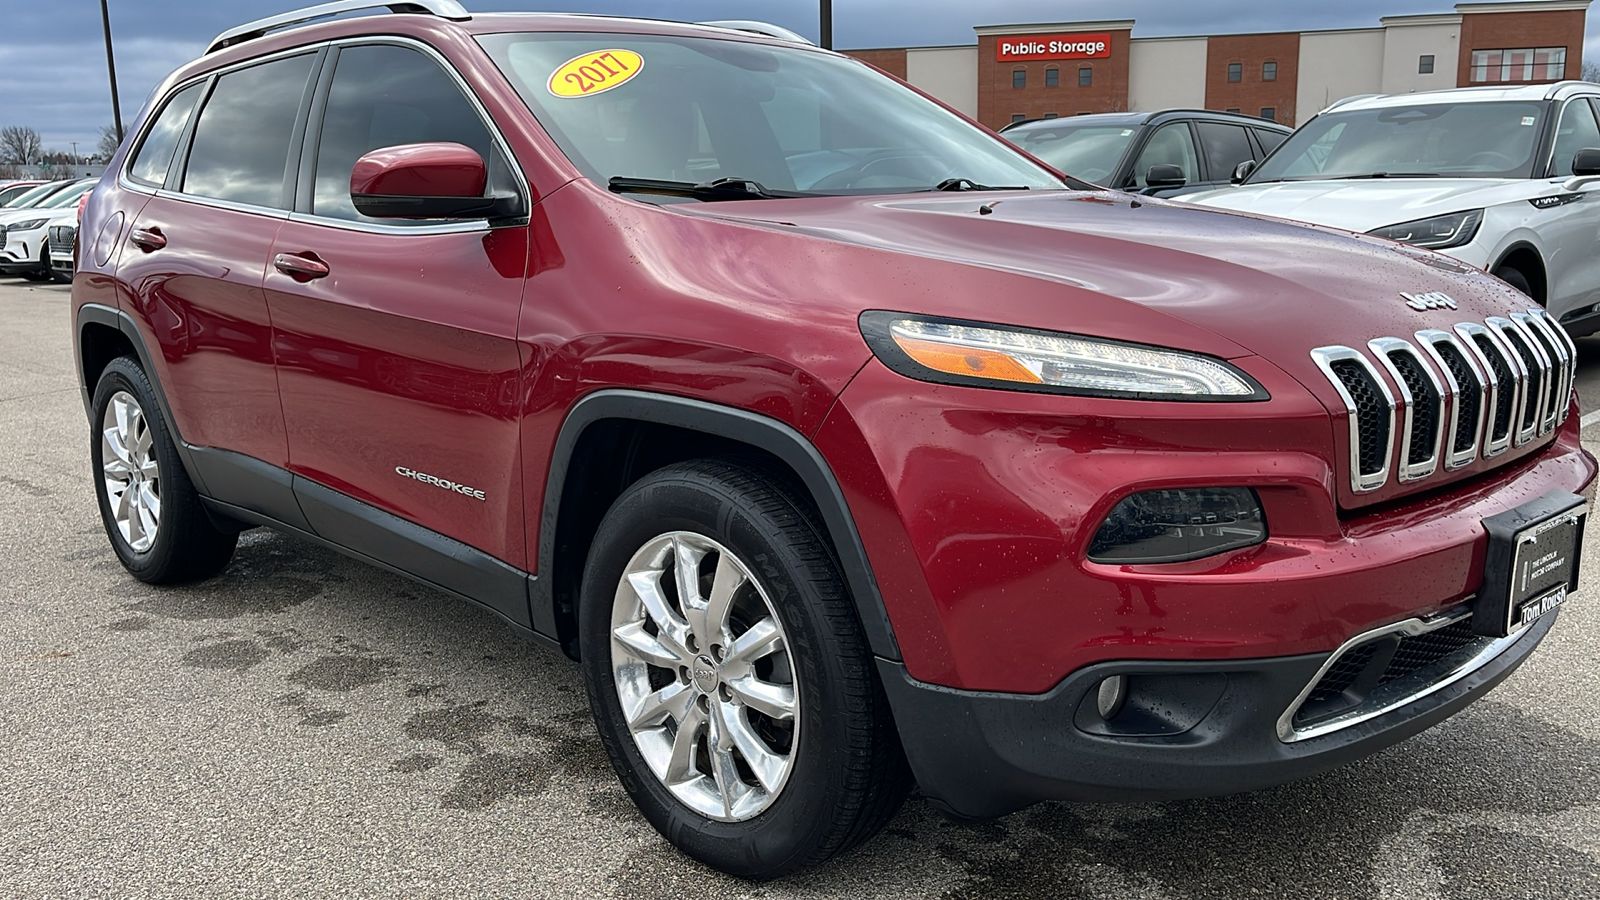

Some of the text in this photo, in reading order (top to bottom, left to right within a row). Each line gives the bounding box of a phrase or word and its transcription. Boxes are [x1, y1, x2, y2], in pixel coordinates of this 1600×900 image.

[1002, 41, 1105, 55] Public Storage
[564, 53, 629, 92] 2017
[1399, 292, 1458, 310] Jeep
[395, 466, 486, 501] CHEROKEE
[1523, 586, 1566, 624] Tom Roush
